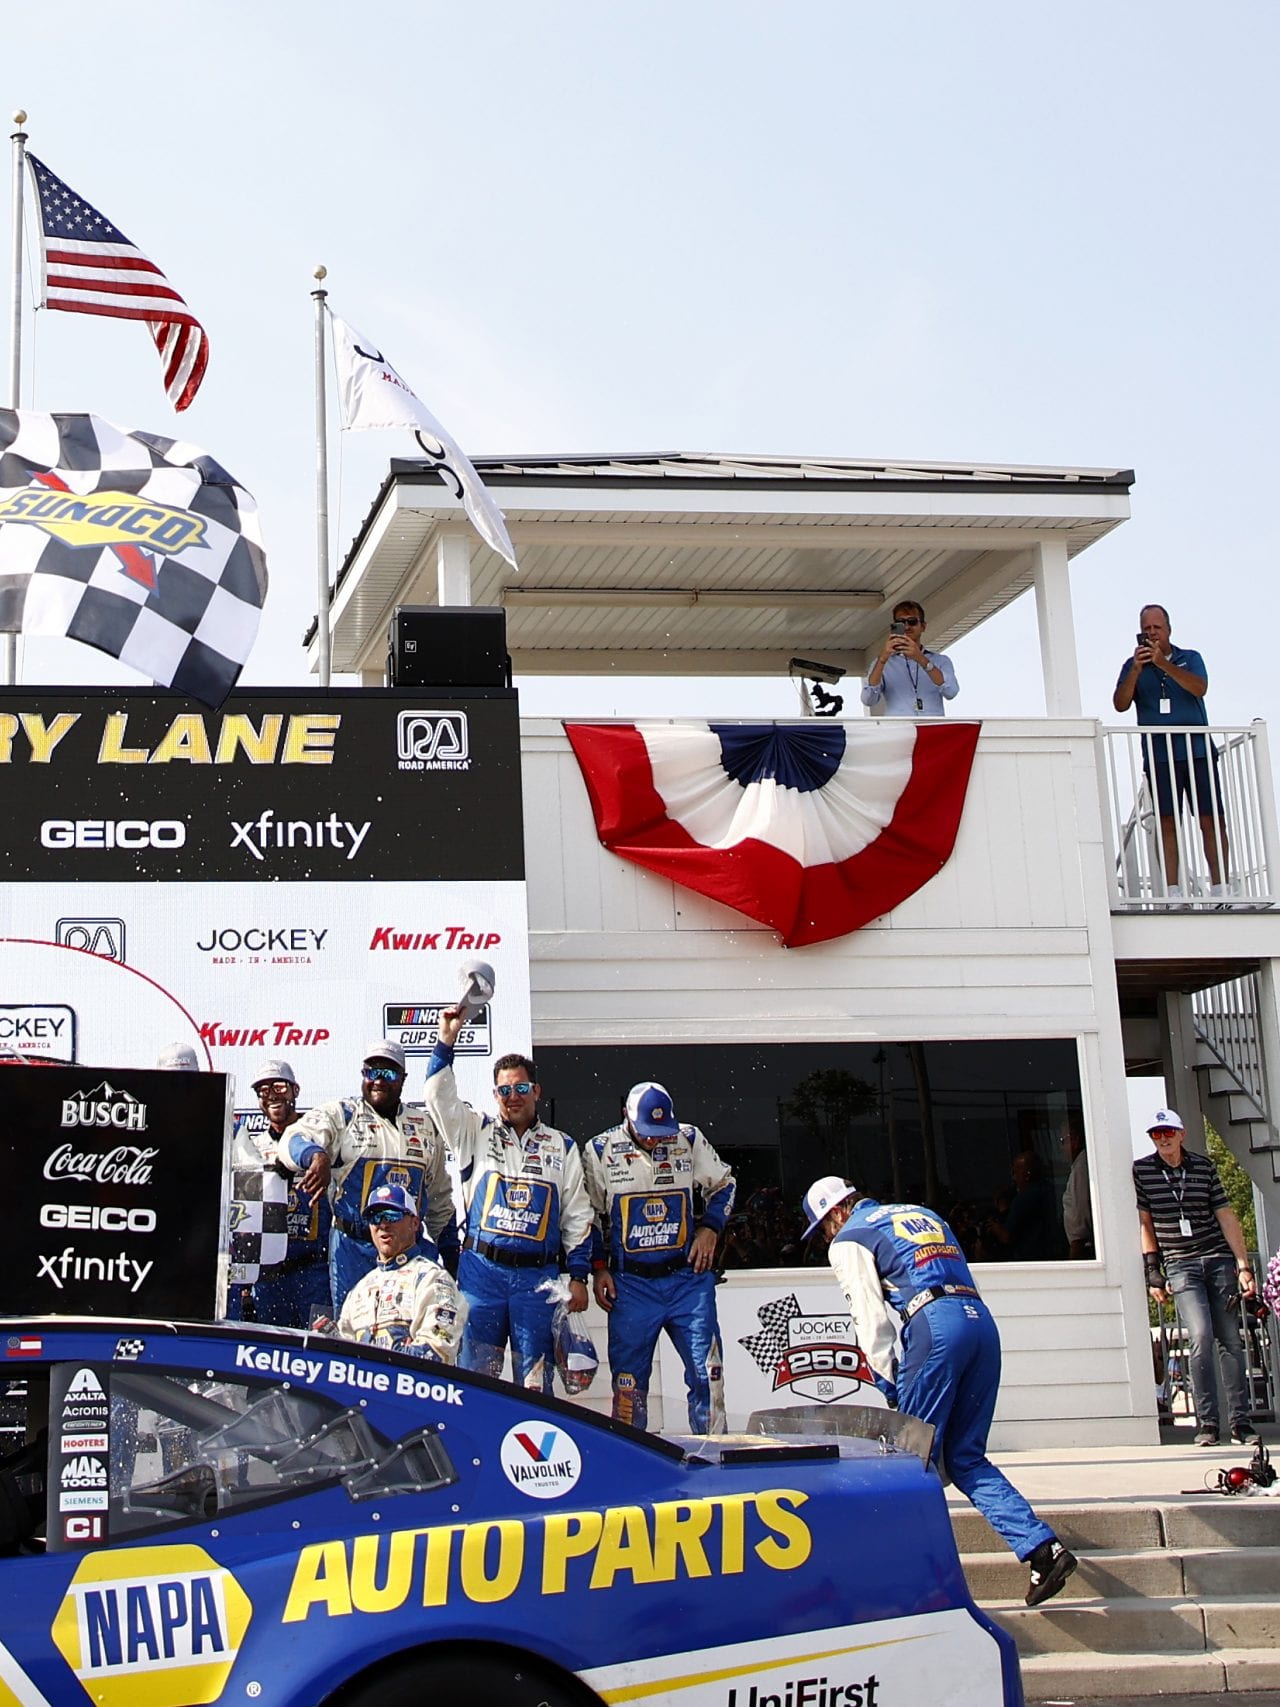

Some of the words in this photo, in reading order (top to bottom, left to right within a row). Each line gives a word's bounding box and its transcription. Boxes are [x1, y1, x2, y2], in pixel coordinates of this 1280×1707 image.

[0, 493, 197, 547] SUNOCO
[97, 711, 341, 764] LANE
[398, 760, 424, 770] ROAD
[426, 760, 469, 770] AMERICA
[41, 820, 186, 848] GEICO
[230, 810, 372, 859] xfinity
[197, 928, 328, 951] JOCKEY
[400, 1031, 427, 1044] CUP
[61, 1099, 148, 1130] BUSCH
[43, 1144, 160, 1185] Coca-Cola
[508, 1190, 529, 1203] NAPA
[40, 1204, 156, 1232] GEICO
[646, 1204, 667, 1218] NAPA
[496, 1219, 527, 1233] CENTER
[900, 1217, 940, 1236] NAPA
[639, 1234, 670, 1247] CENTER
[914, 1245, 936, 1263] AUTO
[36, 1247, 153, 1292] xfinity
[792, 1321, 851, 1335] JOCKEY
[788, 1350, 859, 1375] 250
[236, 1345, 324, 1384] Kelley
[328, 1360, 390, 1391] Blue
[396, 1374, 464, 1406] Book
[64, 1392, 107, 1402] AXALTA
[62, 1405, 109, 1417] Acronis
[63, 1438, 105, 1448] HOOTERS
[61, 1455, 108, 1478] MAC
[510, 1460, 574, 1483] VALVOLINE
[61, 1478, 107, 1488] TOOLS
[64, 1496, 104, 1506] SIEMENS
[66, 1517, 101, 1538] CI
[282, 1519, 524, 1623] AUTO
[541, 1488, 812, 1594] PARTS
[84, 1576, 224, 1668] NAPA
